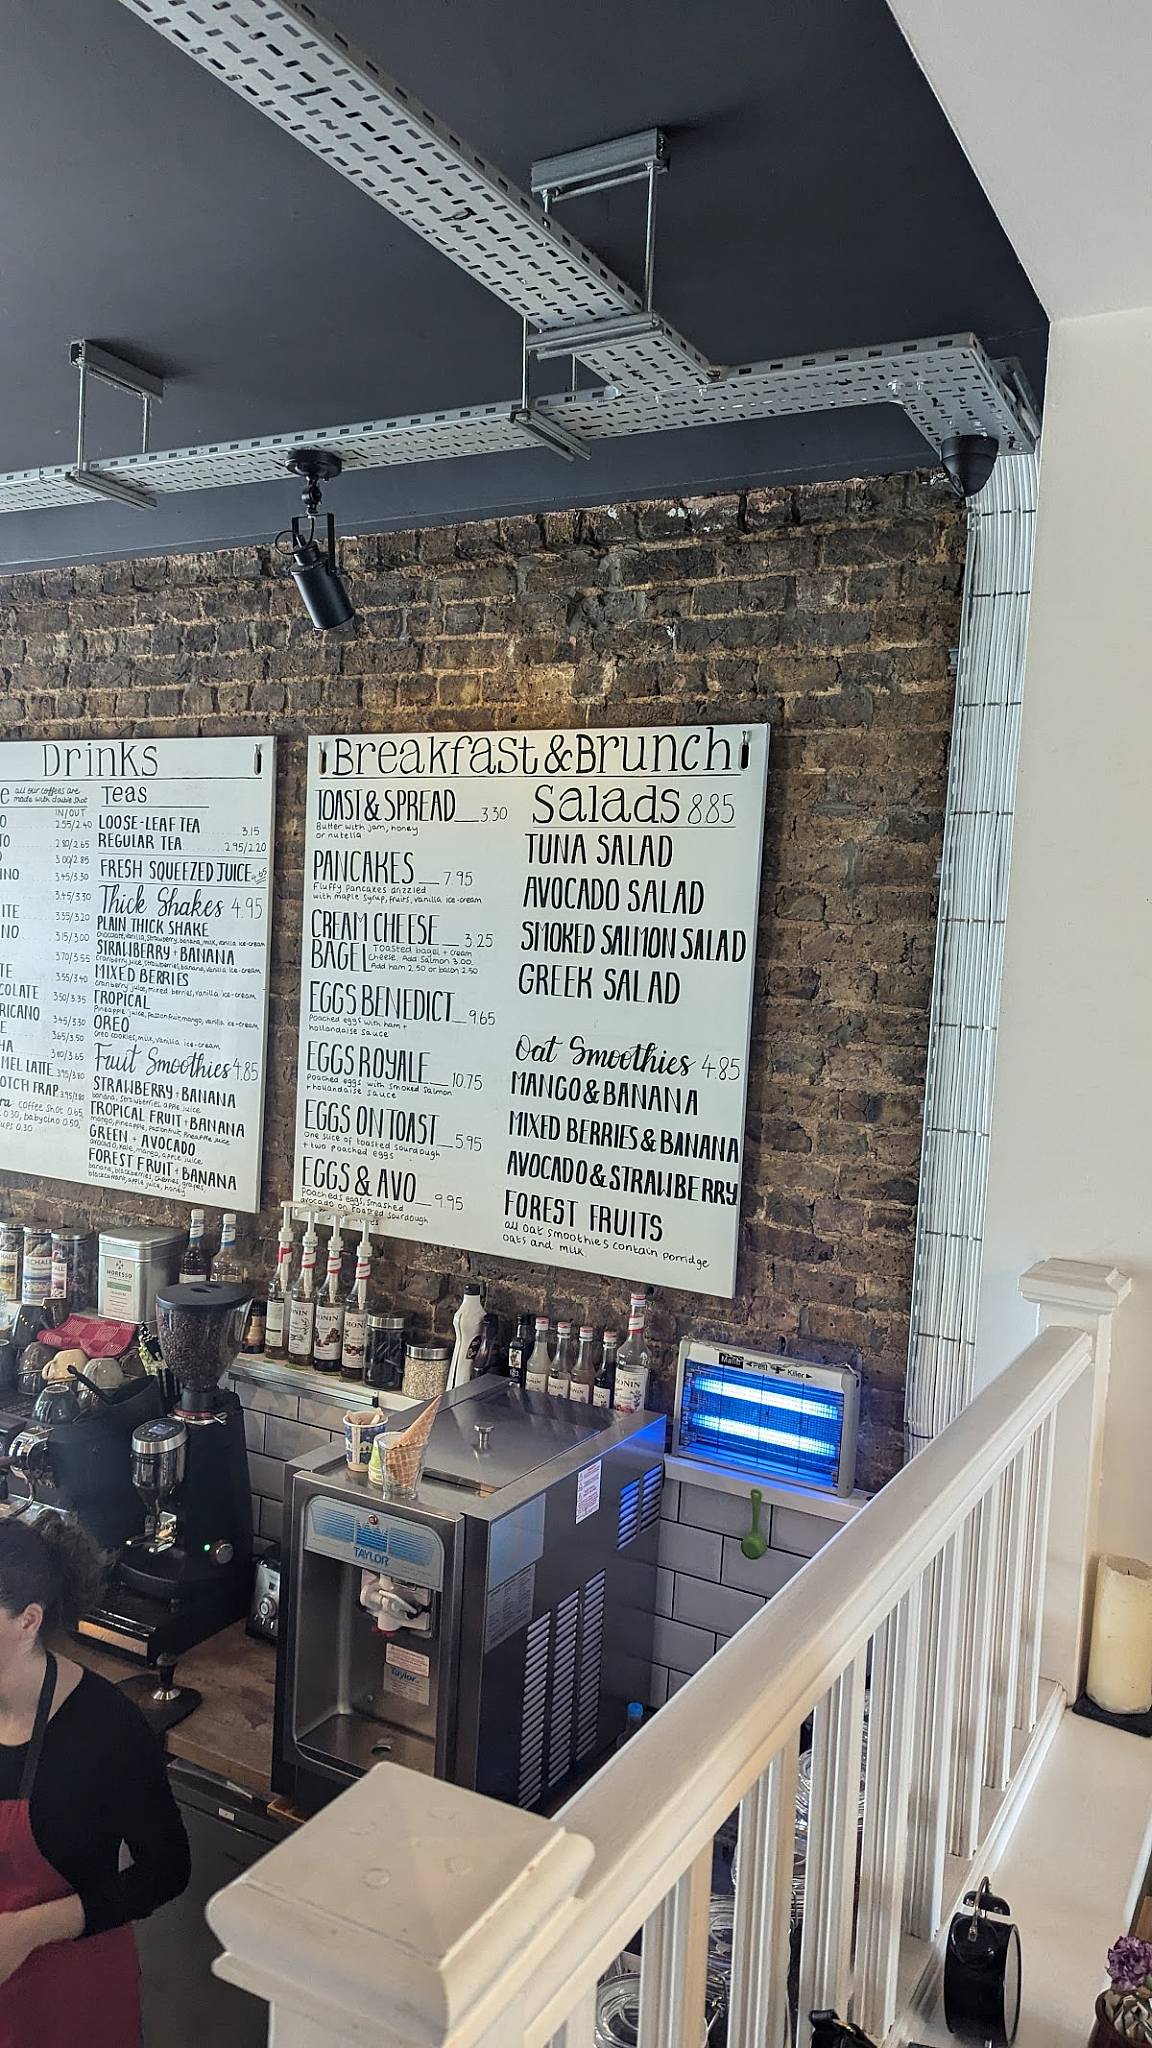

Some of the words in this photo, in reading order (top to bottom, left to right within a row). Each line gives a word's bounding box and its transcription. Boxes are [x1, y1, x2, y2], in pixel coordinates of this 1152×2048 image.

[42, 741, 158, 777] Drinks
[101, 786, 147, 804] Teas
[532, 784, 680, 824] Salads
[99, 814, 176, 831] LOOSE-LEAF
[180, 817, 200, 833] TEA
[316, 822, 342, 830] Butter
[391, 824, 418, 836] honey
[98, 833, 154, 849] REGULAR
[161, 836, 182, 850] TEA
[525, 834, 586, 864] TUNA
[596, 834, 673, 867] SALAD
[101, 859, 142, 878] FRESH
[150, 861, 213, 882] SQUEEZED
[217, 862, 252, 882] JUICE
[313, 850, 414, 884] PANCAKES
[99, 884, 147, 914] Thick
[157, 886, 224, 917] Shakes
[313, 882, 342, 894] Fluffy
[334, 892, 360, 902] maple
[414, 896, 442, 904] vanilla
[522, 876, 620, 910] AVOCADO
[628, 880, 704, 914] SALAD
[97, 915, 126, 932] PLAIN
[130, 918, 164, 934] THICK
[168, 920, 209, 937] SHAKE
[312, 909, 368, 942] CREAM
[374, 912, 440, 946] CHEESE
[520, 920, 596, 954] SMOKED
[600, 924, 676, 958] SALMON
[680, 928, 746, 962] SALAD
[97, 939, 170, 960] STRAWBERRY
[180, 947, 235, 965] BANANA
[311, 938, 372, 972] BAGEL
[96, 964, 135, 982] MIXED
[140, 968, 189, 986] BERRIES
[518, 963, 593, 999] GREEK
[603, 968, 680, 1005] SALAD
[94, 990, 150, 1009] TROPICAL
[309, 980, 356, 1014] EGGS
[361, 984, 455, 1022] BENEDICT
[94, 1014, 130, 1032] OREO
[364, 1019, 381, 1028] with
[94, 1042, 142, 1073] Fruit
[146, 1046, 231, 1079] Smoothies
[232, 1058, 259, 1082] 4.85
[307, 1040, 354, 1076] EGGS
[359, 1046, 431, 1084] ROYALE
[452, 1072, 483, 1091] 10.75
[515, 1034, 563, 1063] Oat
[569, 1036, 696, 1077] Smoothies
[701, 1054, 741, 1080] 4.85
[33, 1082, 59, 1097] FRAP
[93, 1076, 173, 1099] STRAWBERRY
[182, 1087, 236, 1108] BANANA
[367, 1080, 385, 1089] with
[90, 1100, 145, 1122] TROPICAL
[150, 1110, 182, 1127] FRUIT
[190, 1117, 245, 1138] BANANA
[304, 1099, 350, 1134] EGGS
[508, 1110, 560, 1140] MIXED
[90, 1124, 128, 1143] GREEN
[142, 1134, 196, 1156] AVOCADO
[314, 1142, 326, 1150] two
[372, 1151, 394, 1160] eggs
[344, 1136, 352, 1146] of
[356, 1138, 391, 1150] toasted
[394, 1142, 441, 1160] sourdough
[89, 1148, 133, 1168] FOREST
[138, 1156, 174, 1176] FRUIT
[182, 1167, 237, 1190] BANANA
[302, 1156, 350, 1193] EGGS
[354, 1165, 372, 1197] &
[377, 1168, 416, 1203] AVO
[388, 1212, 429, 1226] sourdough
[504, 1190, 578, 1228] FOREST
[589, 1204, 664, 1242] FRUITS
[502, 1233, 528, 1246] oats
[530, 1238, 554, 1250] and
[559, 1244, 584, 1257] milk
[504, 1220, 518, 1230] all
[522, 1224, 543, 1236] oat
[547, 1228, 609, 1249] smoothies
[612, 1240, 658, 1258] contain
[662, 1250, 710, 1270] porridge
[353, 1546, 390, 1568] TAYLOR
[391, 1667, 418, 1683] Taylor
